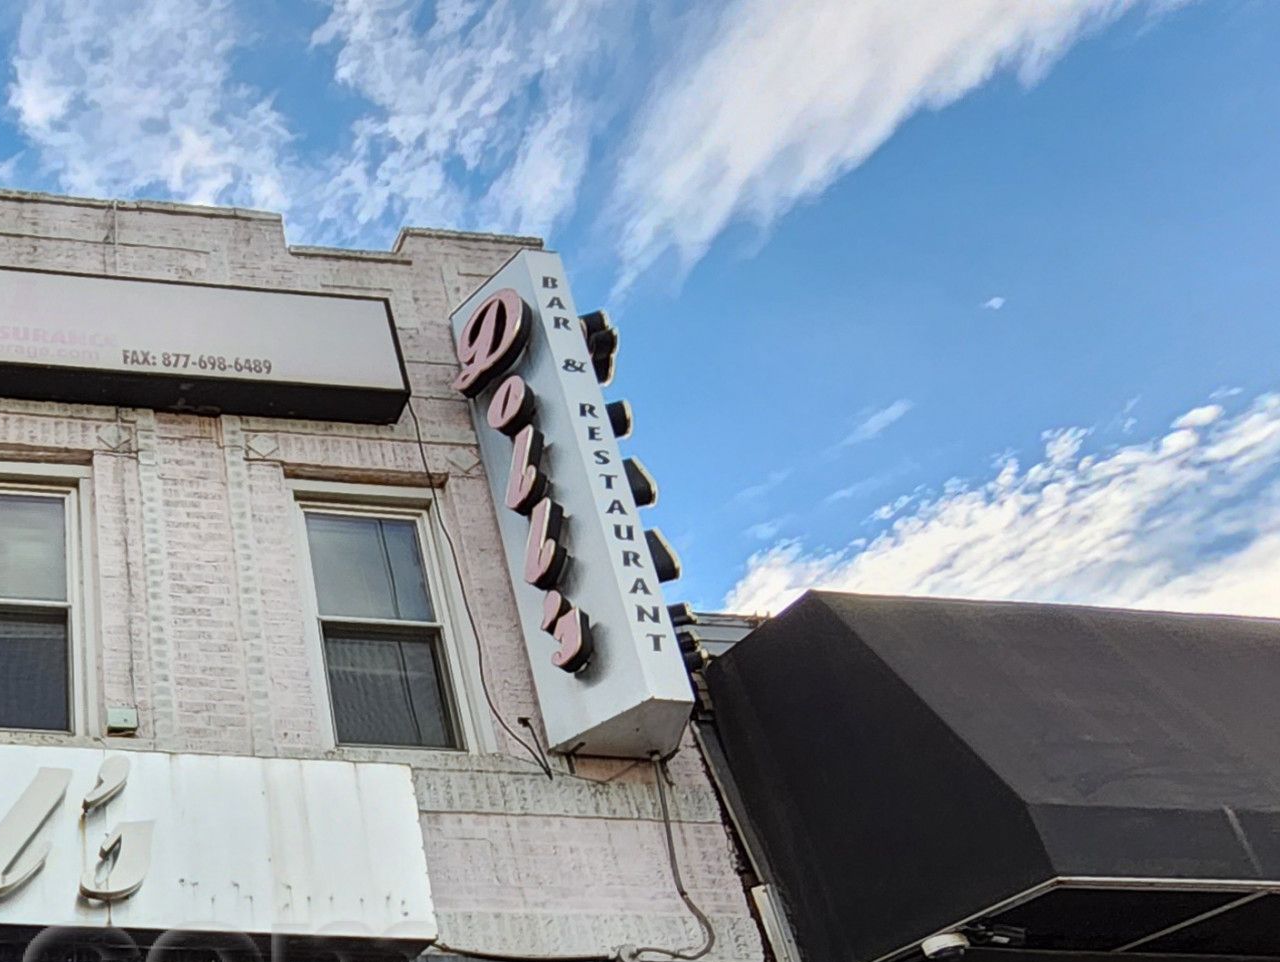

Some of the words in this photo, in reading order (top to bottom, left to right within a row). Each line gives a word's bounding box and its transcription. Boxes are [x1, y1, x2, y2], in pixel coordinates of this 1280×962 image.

[121, 350, 158, 368] FAX:
[161, 351, 273, 376] 877-698-6489
[541, 275, 573, 332] BAR
[561, 359, 588, 374] &
[578, 402, 668, 653] RESTAURANT
